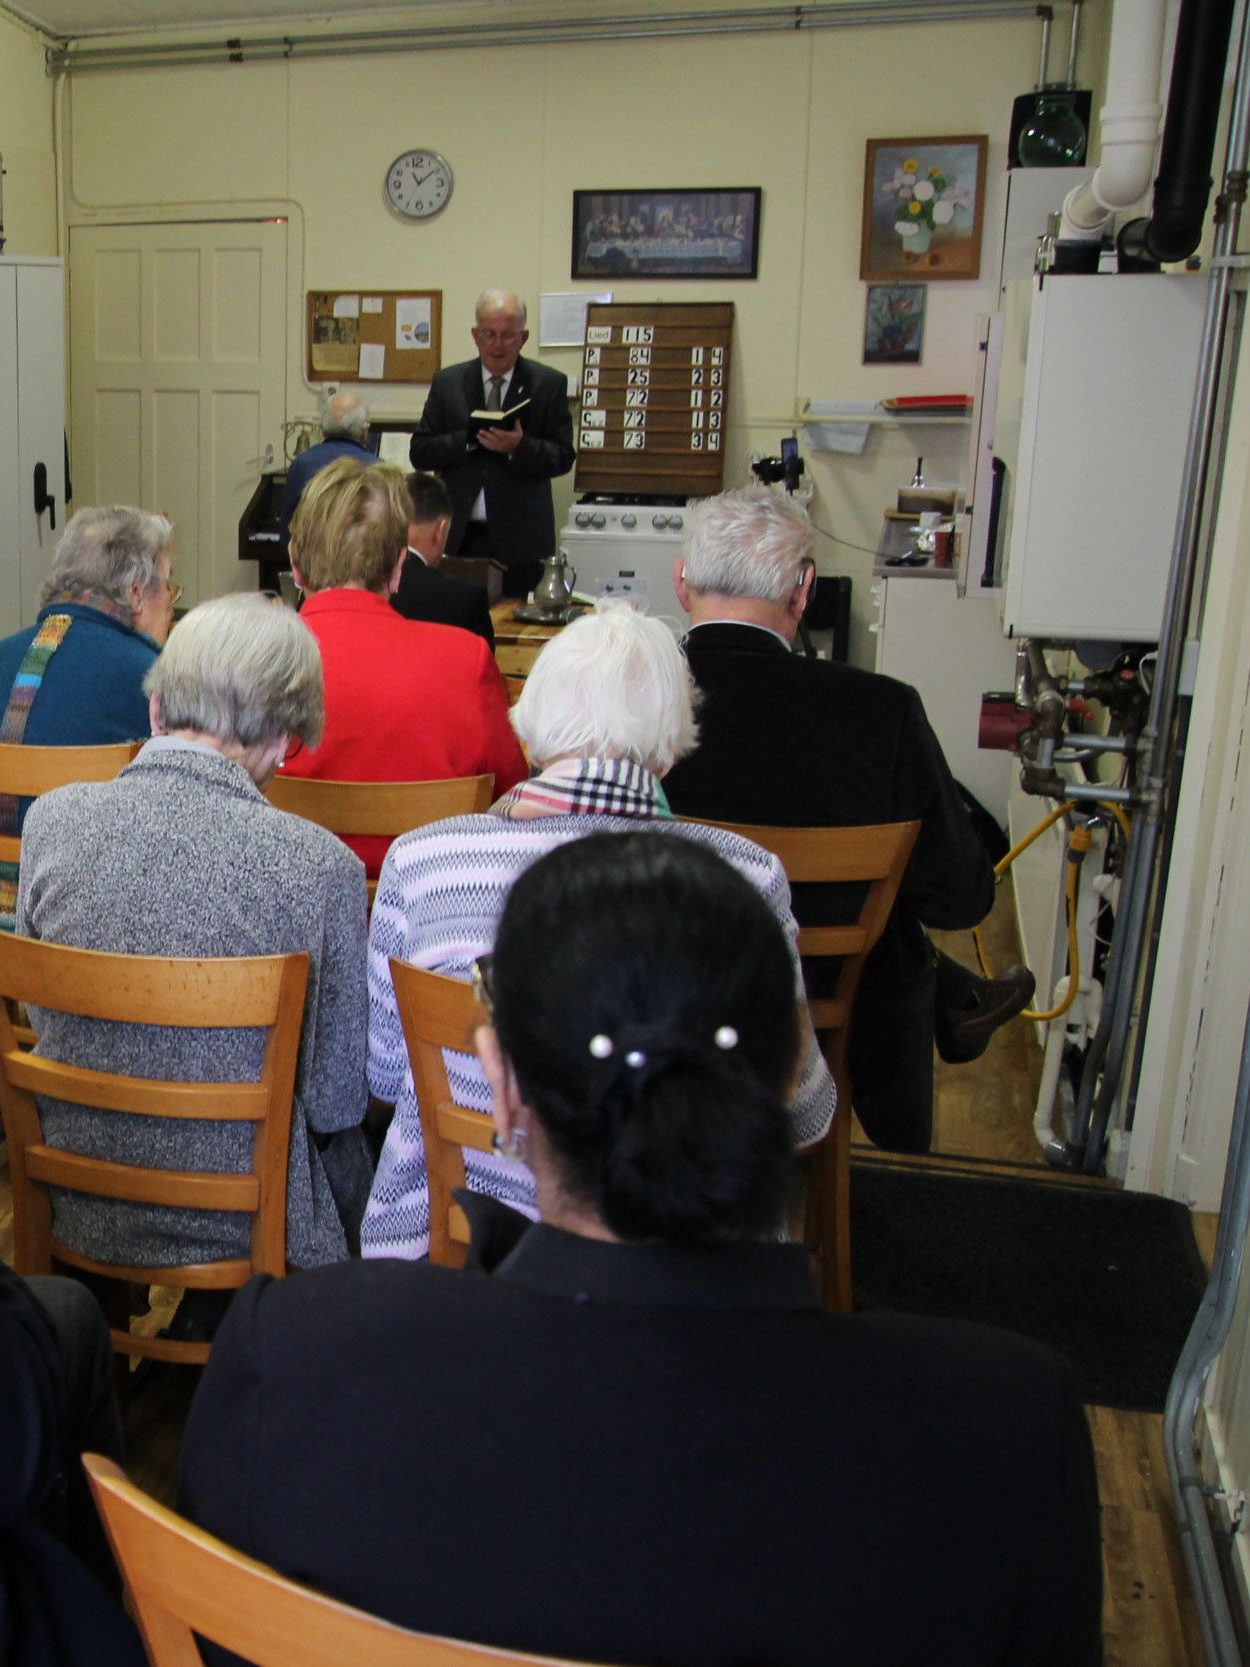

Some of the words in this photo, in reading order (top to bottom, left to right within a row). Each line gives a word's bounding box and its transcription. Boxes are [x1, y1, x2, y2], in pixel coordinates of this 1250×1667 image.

[412, 157, 424, 168] 12
[393, 179, 402, 190] 9
[436, 178, 444, 188] 3
[415, 200, 424, 210] 6
[589, 329, 609, 341] Lied
[625, 328, 652, 342] 115
[630, 349, 650, 364] 84
[713, 349, 722, 363] 4
[630, 368, 648, 384] 25
[693, 370, 702, 385] 2
[712, 370, 721, 385] 3
[627, 389, 647, 405] 72
[713, 391, 721, 406] 2
[625, 411, 645, 427] 72
[711, 413, 720, 428] 3
[625, 432, 644, 448] 73
[693, 433, 701, 448] 3
[710, 434, 718, 448] 4
